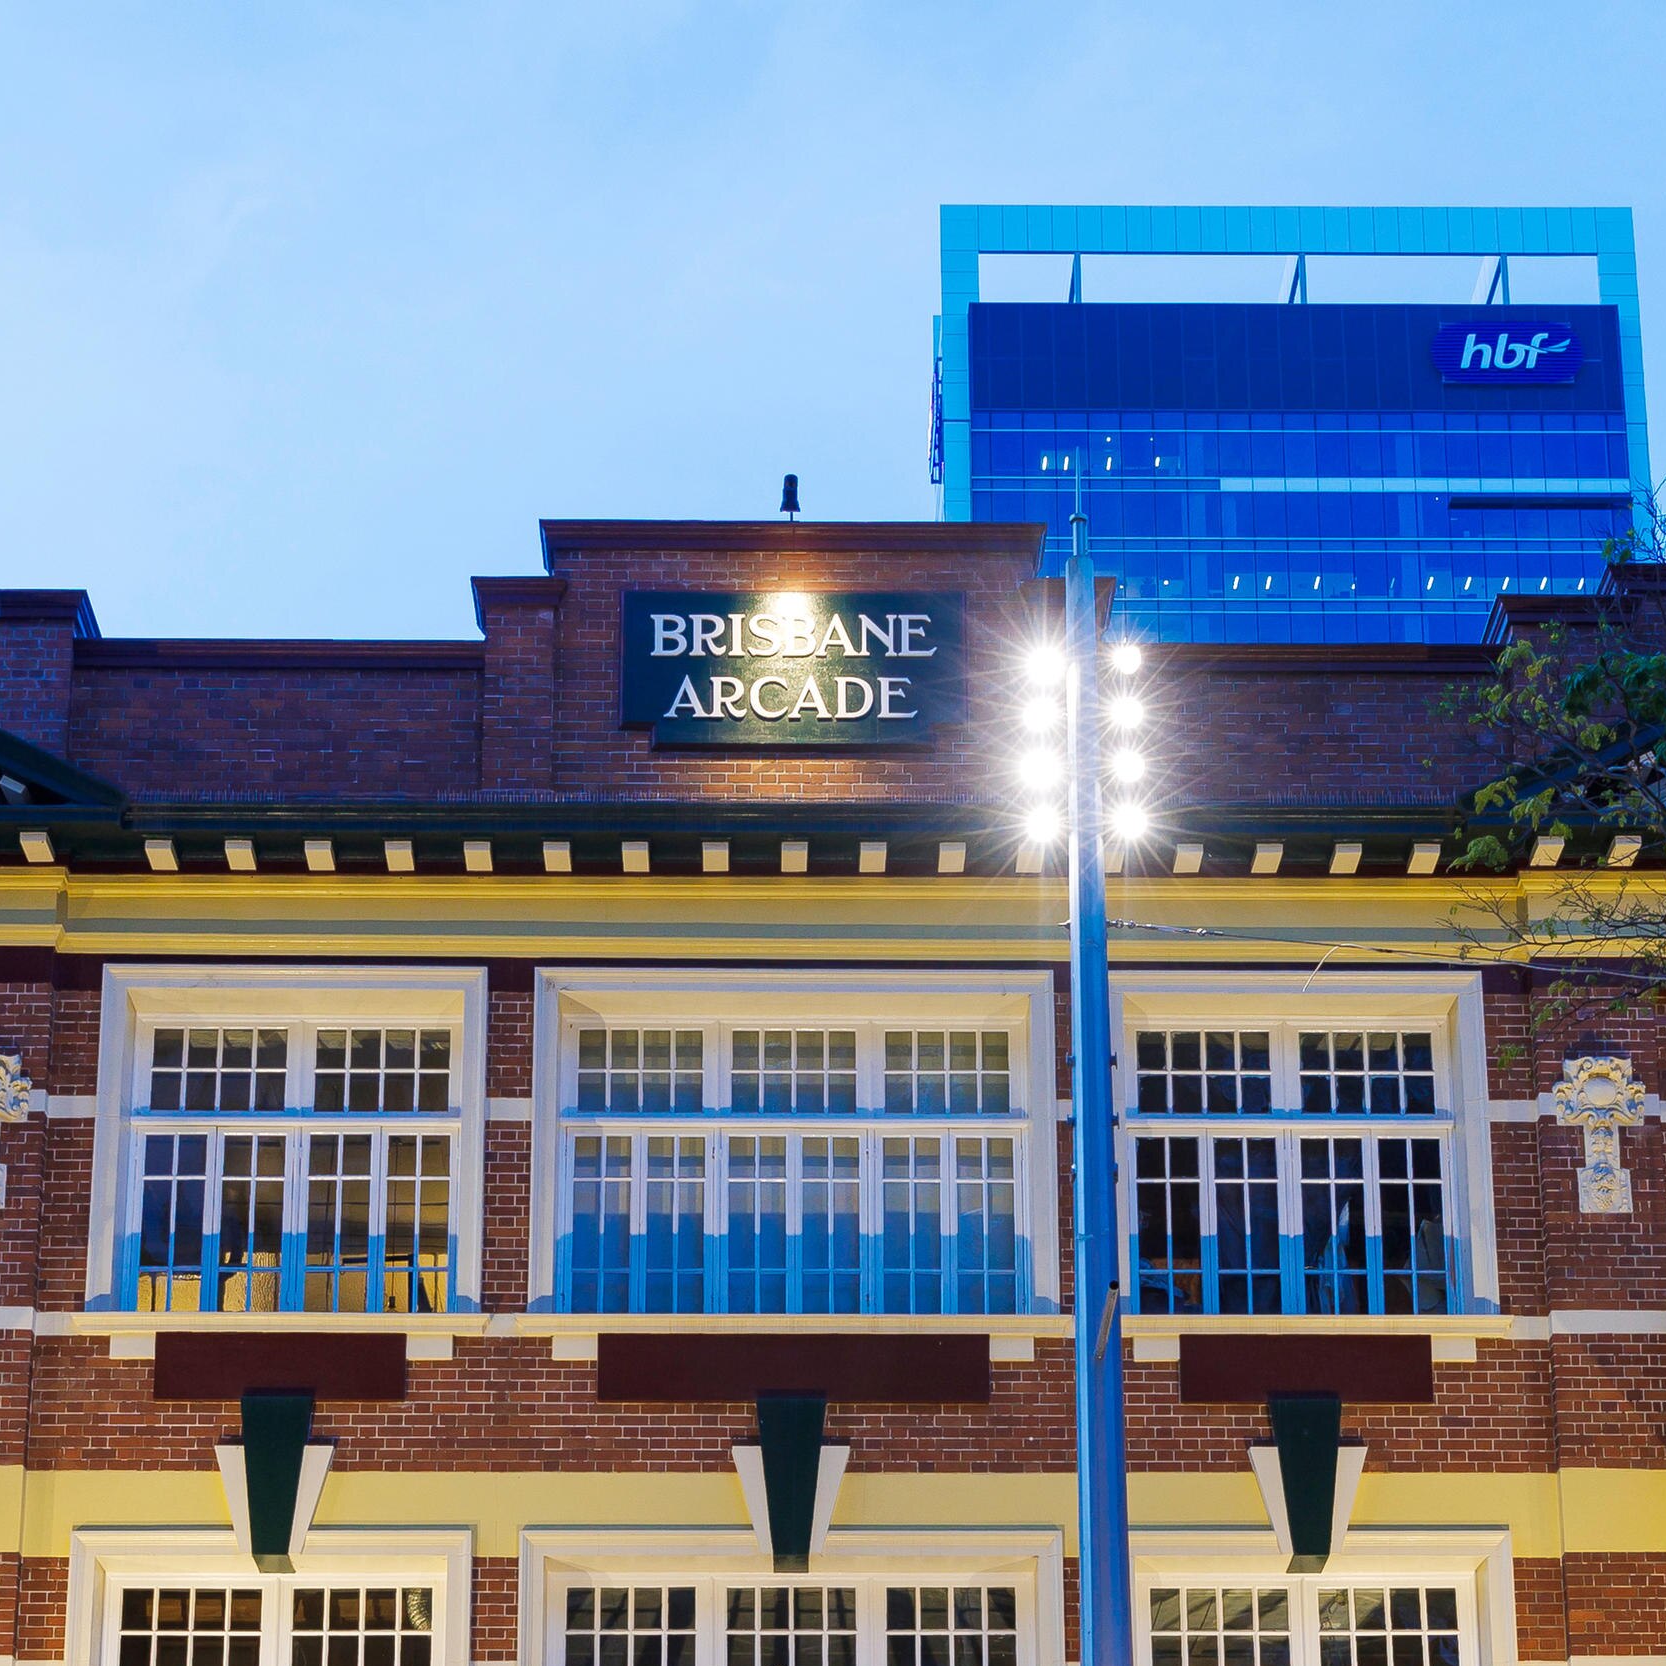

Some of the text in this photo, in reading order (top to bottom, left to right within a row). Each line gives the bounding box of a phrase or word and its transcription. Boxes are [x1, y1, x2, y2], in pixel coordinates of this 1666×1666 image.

[1460, 333, 1549, 369] hbf
[650, 613, 938, 657] BRISBANE
[663, 674, 919, 719] ARCADE
